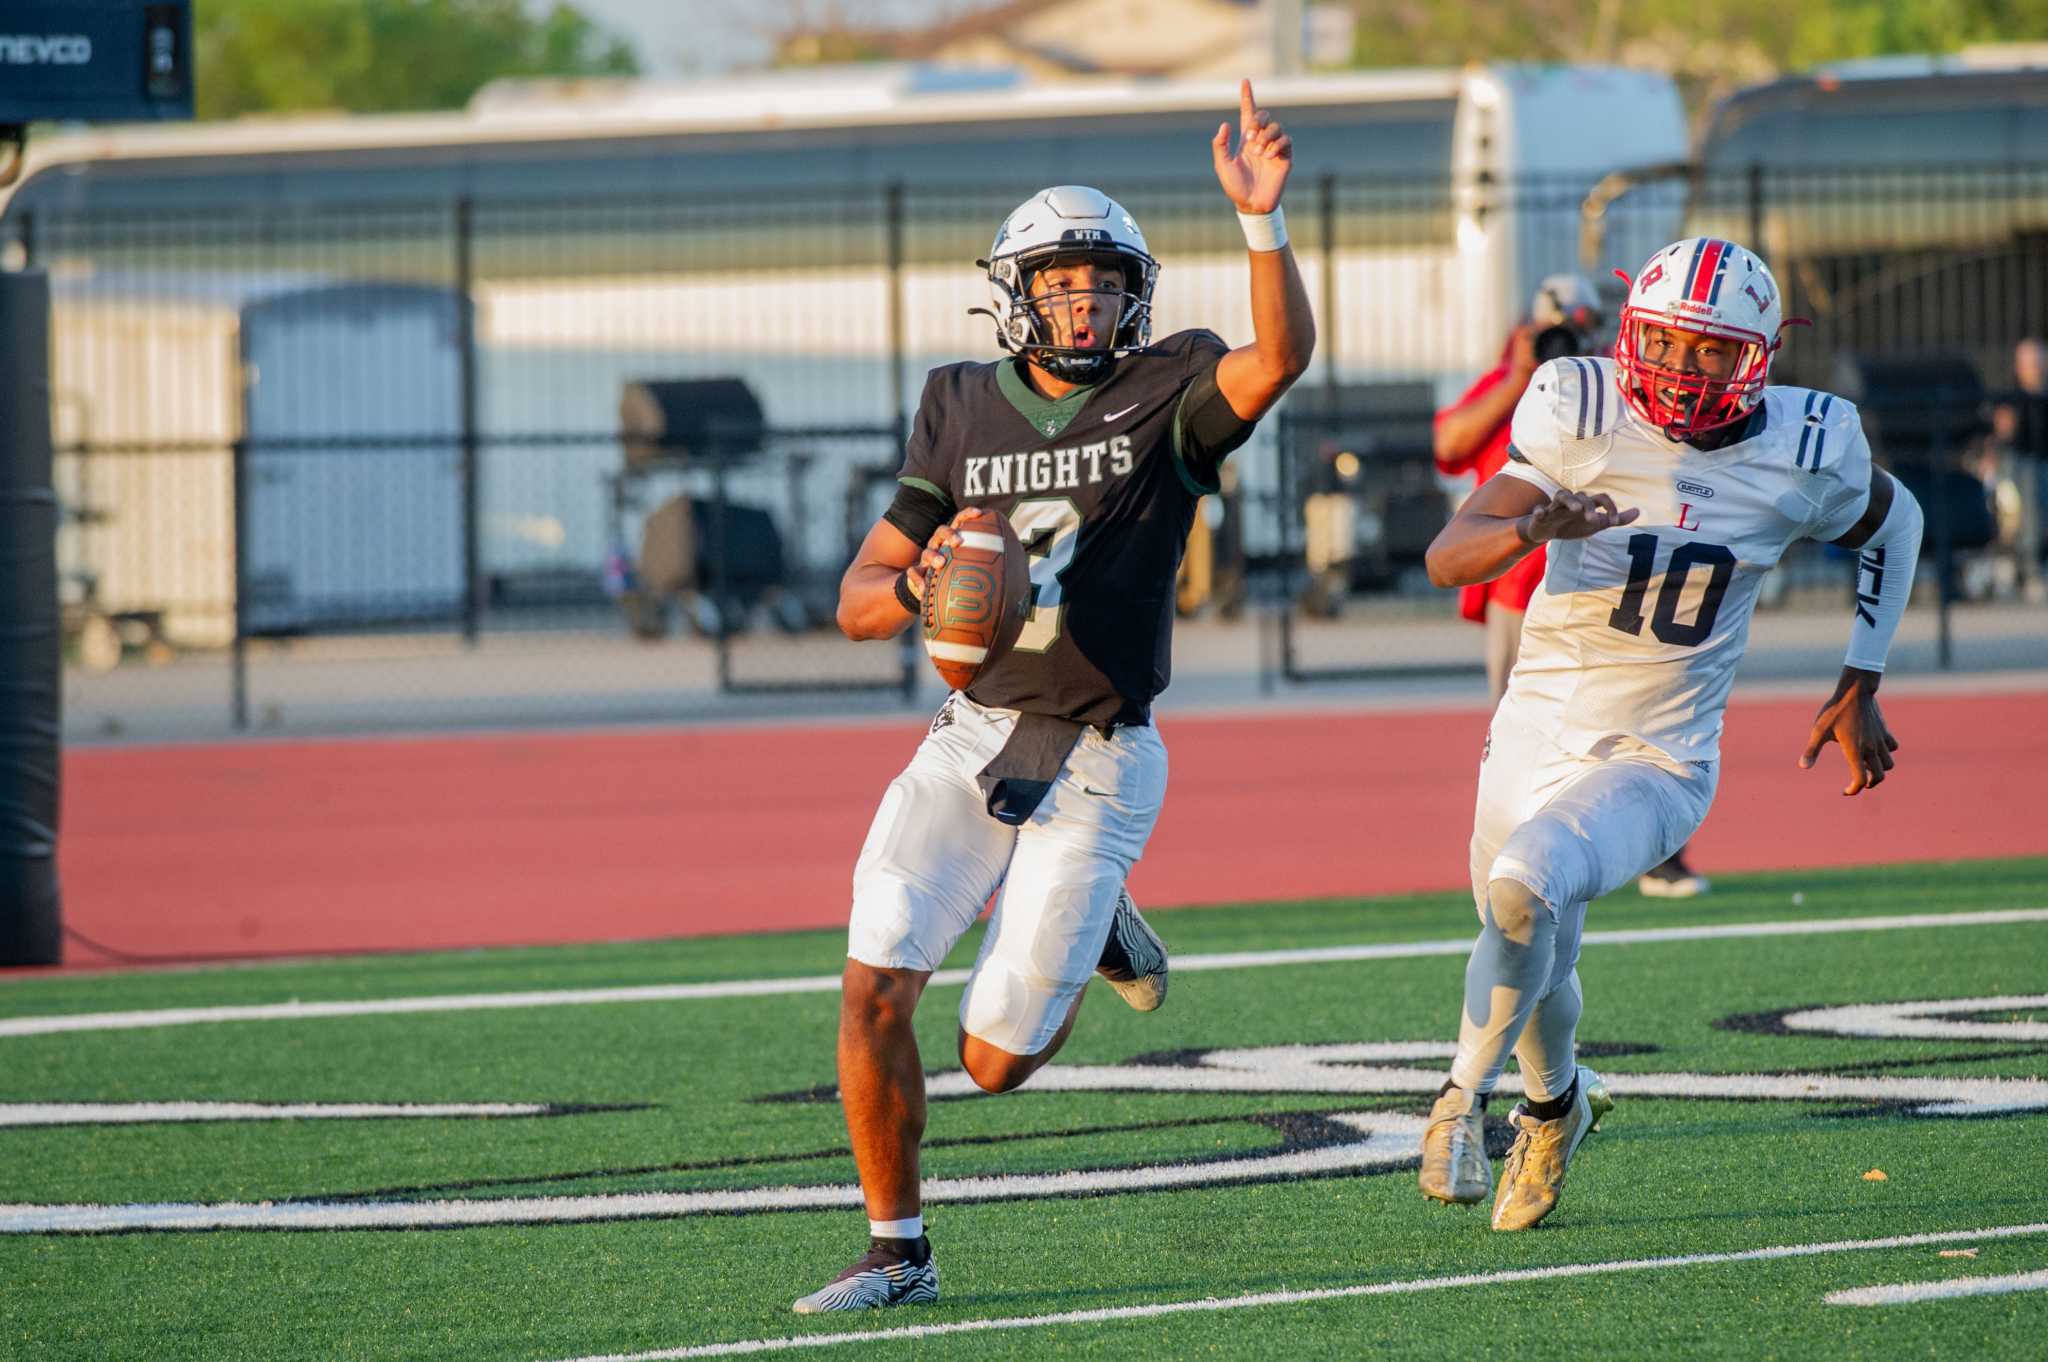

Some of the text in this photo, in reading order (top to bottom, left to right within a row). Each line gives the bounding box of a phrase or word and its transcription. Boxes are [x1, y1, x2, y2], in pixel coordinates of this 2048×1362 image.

[1680, 302, 1713, 316] Riddell
[963, 433, 1134, 498] KNIGHTS
[1672, 502, 1700, 532] L
[1608, 533, 1737, 647] 10
